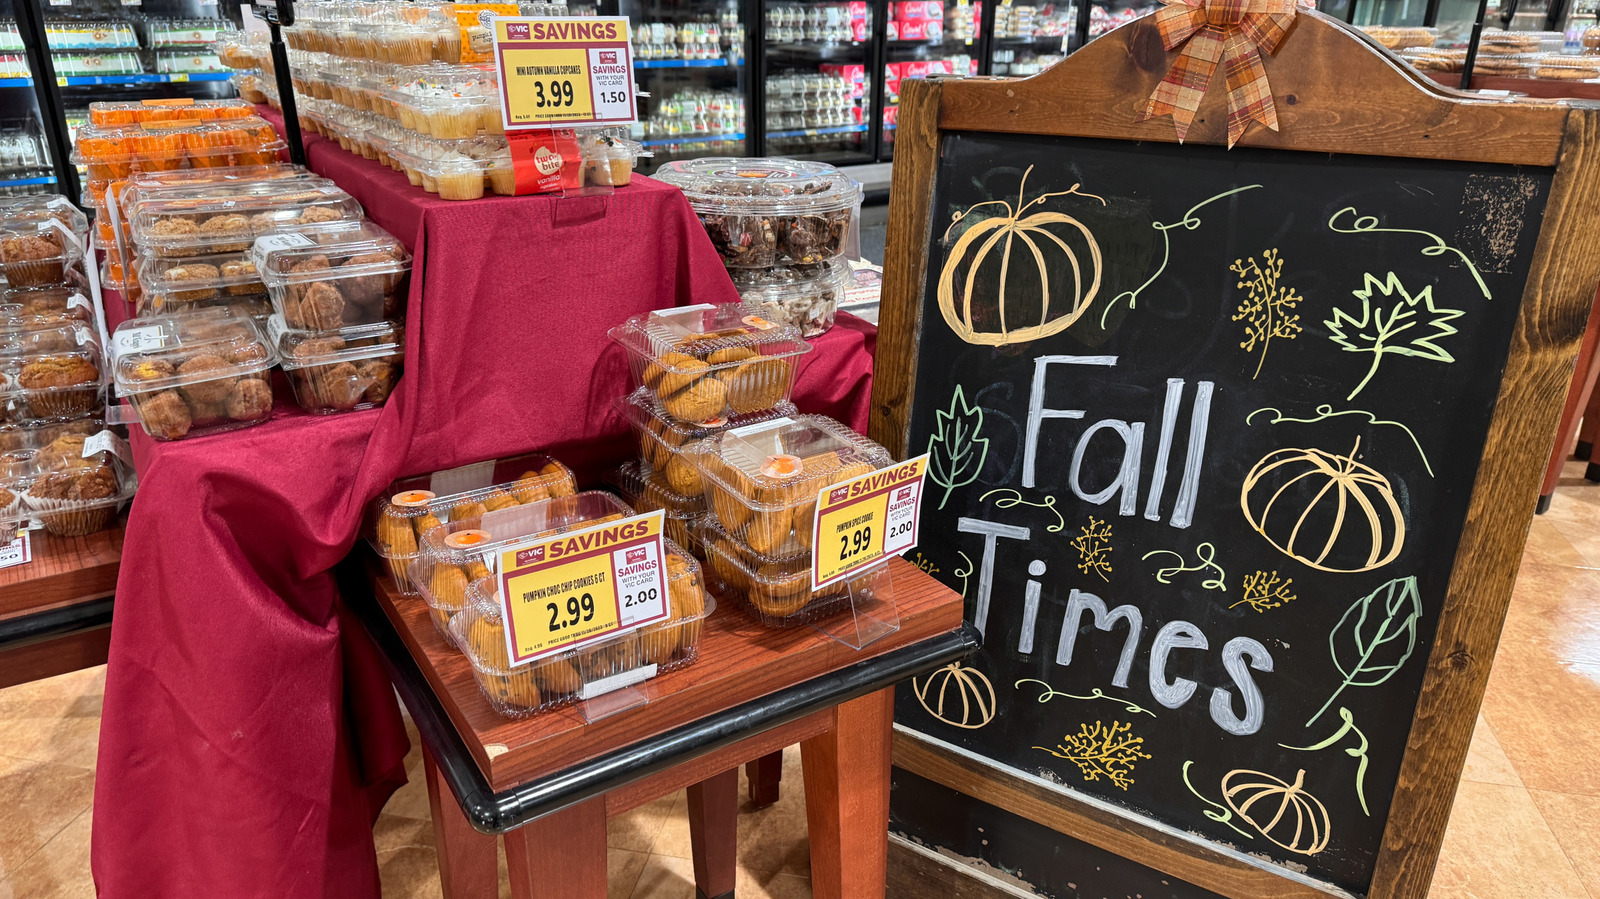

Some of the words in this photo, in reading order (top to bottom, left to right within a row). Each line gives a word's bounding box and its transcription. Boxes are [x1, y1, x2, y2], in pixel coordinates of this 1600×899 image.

[534, 23, 617, 40] SAVINGS
[527, 66, 543, 75] AUTUMN
[543, 66, 560, 75] VANILLA
[560, 65, 581, 74] CUPCAKES
[593, 65, 626, 74] SAVINGS
[534, 80, 573, 108] 3.99
[600, 91, 626, 103] 1.50
[542, 161, 559, 170] bite
[537, 175, 560, 184] vanilla
[1022, 354, 1214, 529] Fall
[837, 487, 848, 495] VIC
[851, 462, 918, 497] SAVINGS
[889, 497, 915, 512] SAVINGS
[836, 521, 851, 533] PUMPKIN
[852, 516, 861, 527] SPICE
[862, 512, 873, 523] COOKIE
[890, 520, 912, 538] 2.00
[528, 548, 543, 557] VIC
[549, 520, 649, 558] SAVINGS
[840, 526, 871, 561] 2.99
[618, 560, 657, 577] SAVINGS
[622, 576, 637, 584] WITH
[638, 571, 655, 579] YOUR
[523, 588, 546, 603] PUMPKIN
[547, 584, 560, 597] CHOC
[561, 581, 572, 593] CHIP
[573, 575, 594, 590] COOKIES
[594, 574, 598, 583] 6
[599, 572, 605, 582] CT
[636, 576, 653, 586] CARD
[624, 588, 657, 608] 2.00
[547, 593, 594, 632] 2.99
[957, 516, 1274, 736] Times
